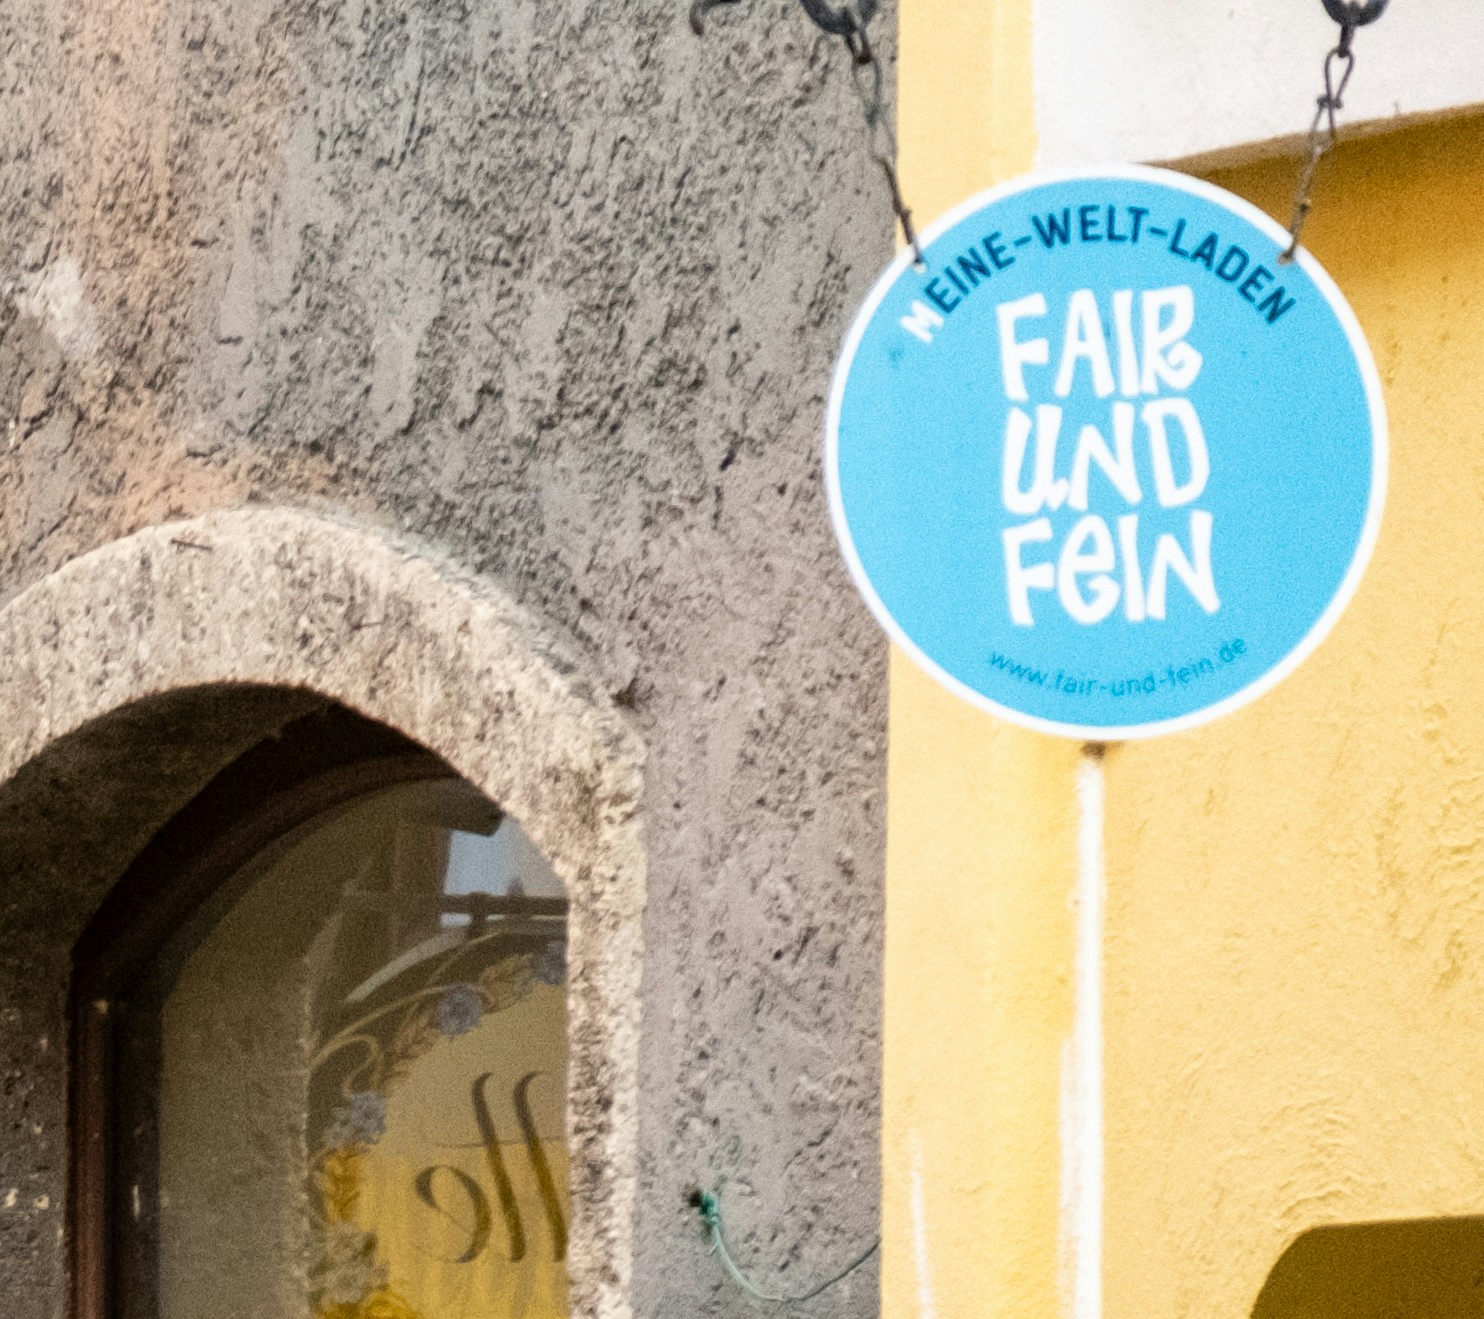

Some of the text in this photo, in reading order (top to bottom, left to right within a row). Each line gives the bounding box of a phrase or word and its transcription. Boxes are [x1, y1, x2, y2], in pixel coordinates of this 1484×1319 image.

[996, 284, 1204, 402] FAIR
[1000, 397, 1211, 516] UND
[987, 636, 1249, 698] www.fair-und-fein.de
